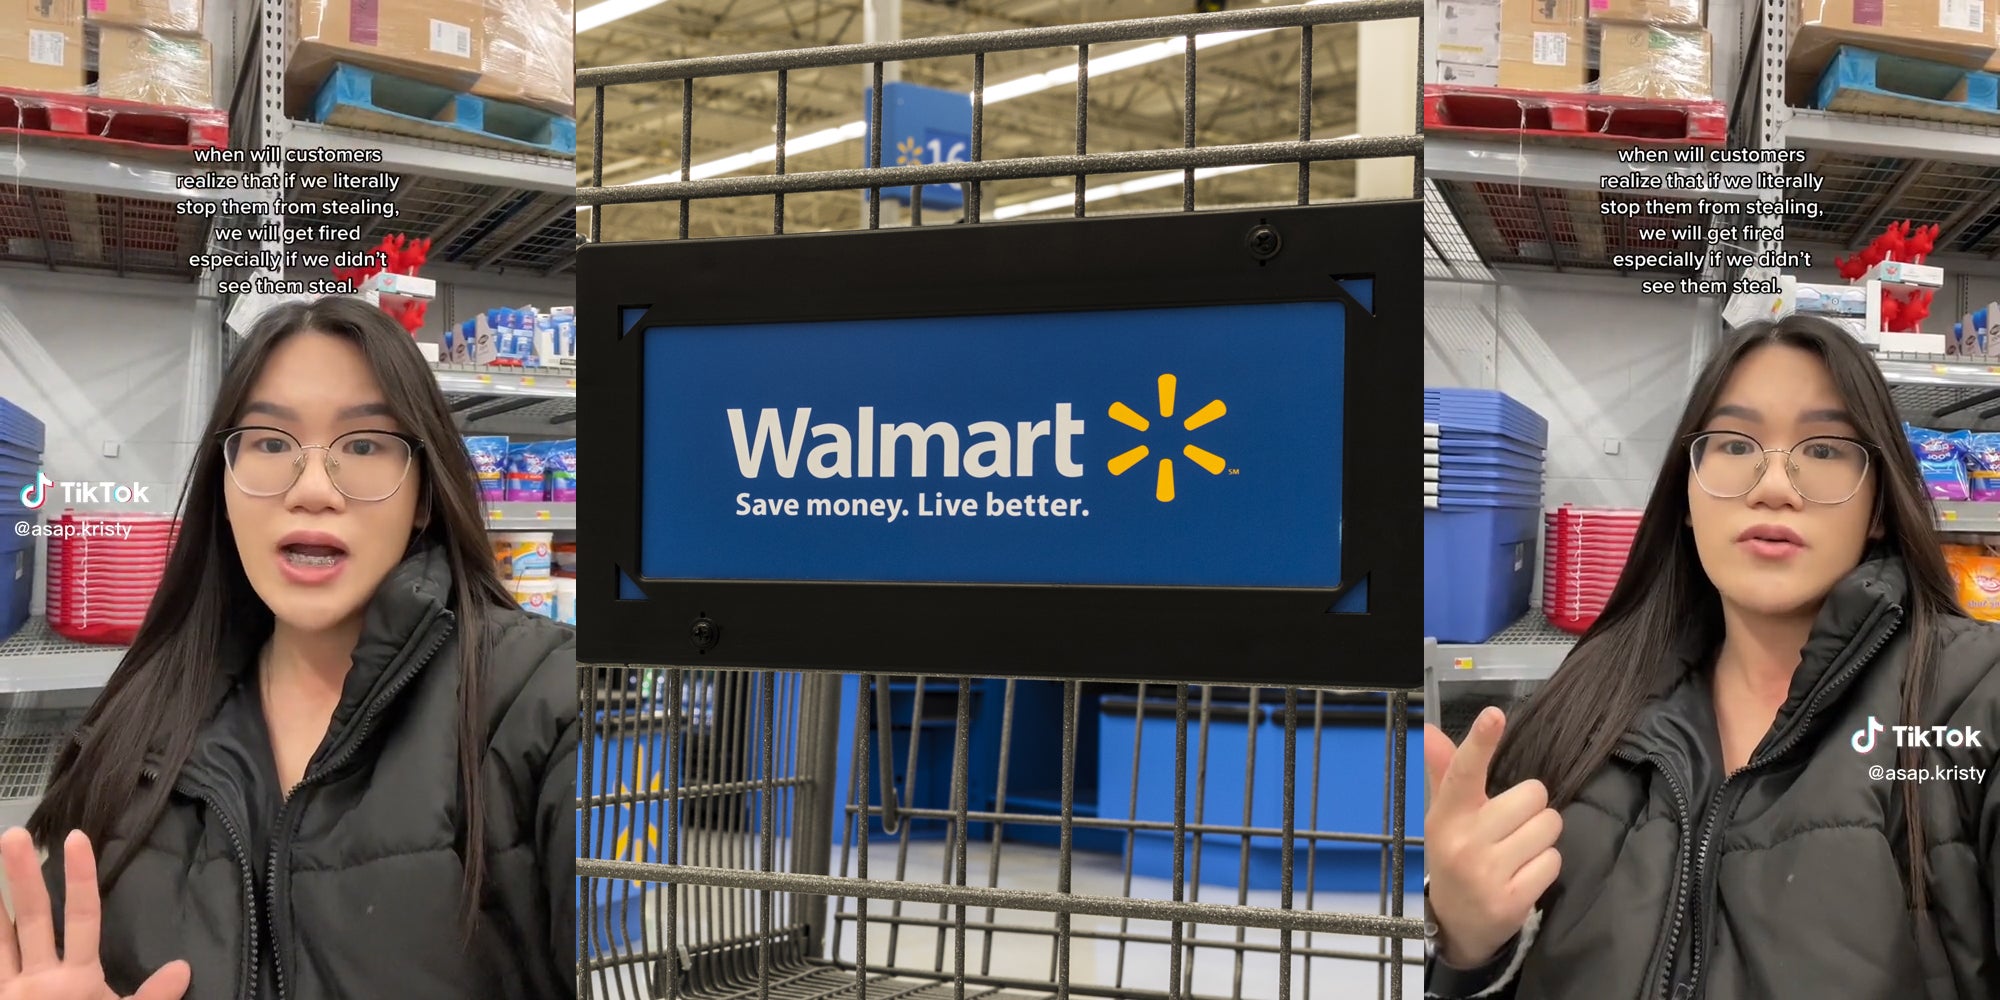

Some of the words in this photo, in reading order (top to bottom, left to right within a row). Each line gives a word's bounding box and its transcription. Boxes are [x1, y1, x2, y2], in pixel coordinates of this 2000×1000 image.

[726, 402, 1085, 479] Walmart
[736, 492, 799, 516] Save
[807, 492, 909, 523] money.
[919, 491, 978, 517] Live
[986, 491, 1090, 517] better.
